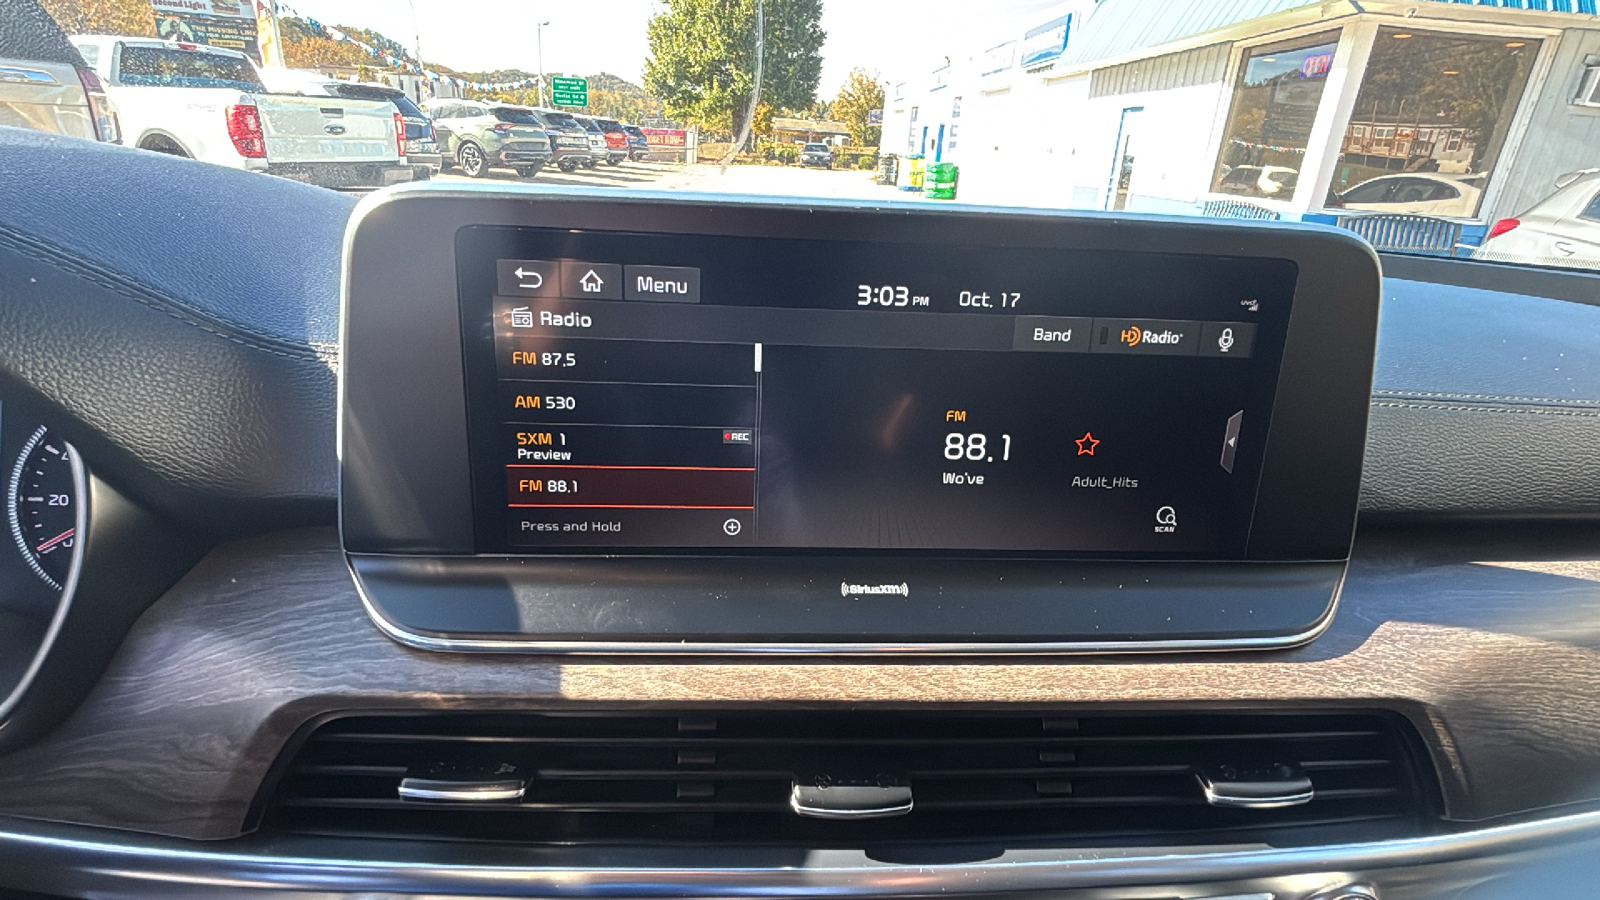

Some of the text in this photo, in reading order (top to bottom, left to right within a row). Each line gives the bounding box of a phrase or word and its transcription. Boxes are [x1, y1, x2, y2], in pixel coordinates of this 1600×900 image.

[1303, 54, 1331, 74] OPEN
[637, 276, 688, 294] Menu
[857, 284, 930, 307] 3:03 PM
[959, 291, 1021, 309] Oct. 17
[540, 311, 592, 328] Radio
[1033, 327, 1072, 342] Band
[512, 352, 576, 367] FM 87.5
[514, 395, 576, 410] AM 530
[946, 410, 967, 422] FM
[516, 432, 566, 446] SXM 1
[731, 432, 749, 441] REC
[517, 448, 571, 461] Preview
[944, 432, 1011, 463] 88.1
[942, 472, 984, 485] Wo've
[1071, 476, 1139, 489] Adult_Hits
[519, 479, 578, 493] FM 88.1
[48, 494, 69, 506] 20
[521, 520, 621, 532] Press and Hold
[848, 584, 902, 594] SiriusXM
